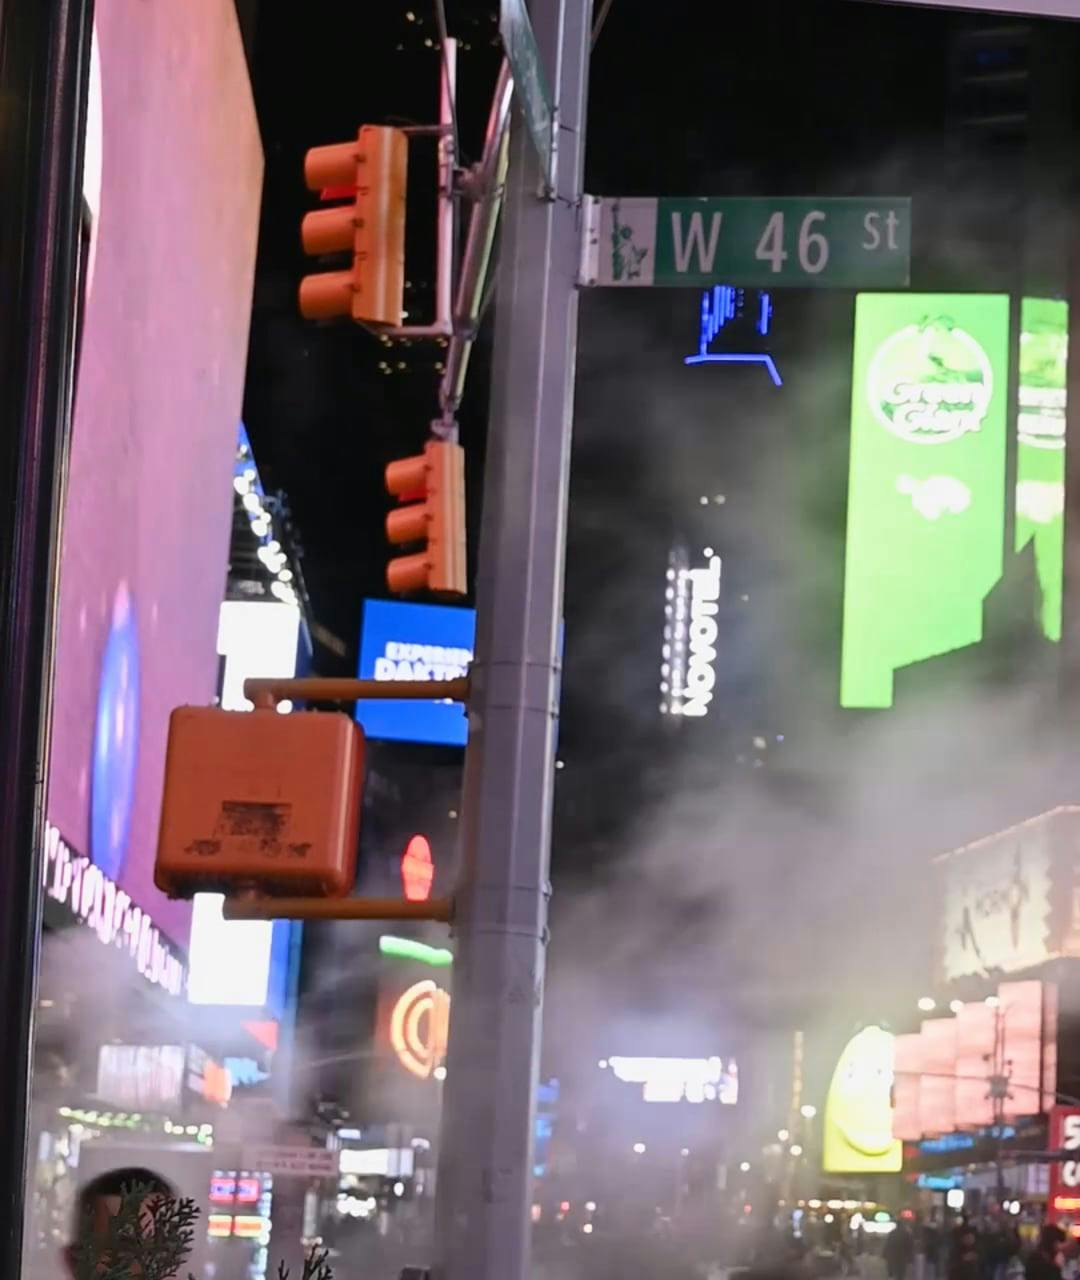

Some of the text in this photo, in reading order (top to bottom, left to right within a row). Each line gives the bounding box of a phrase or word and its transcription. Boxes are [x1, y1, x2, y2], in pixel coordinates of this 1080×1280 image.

[671, 210, 899, 274] W 46 St
